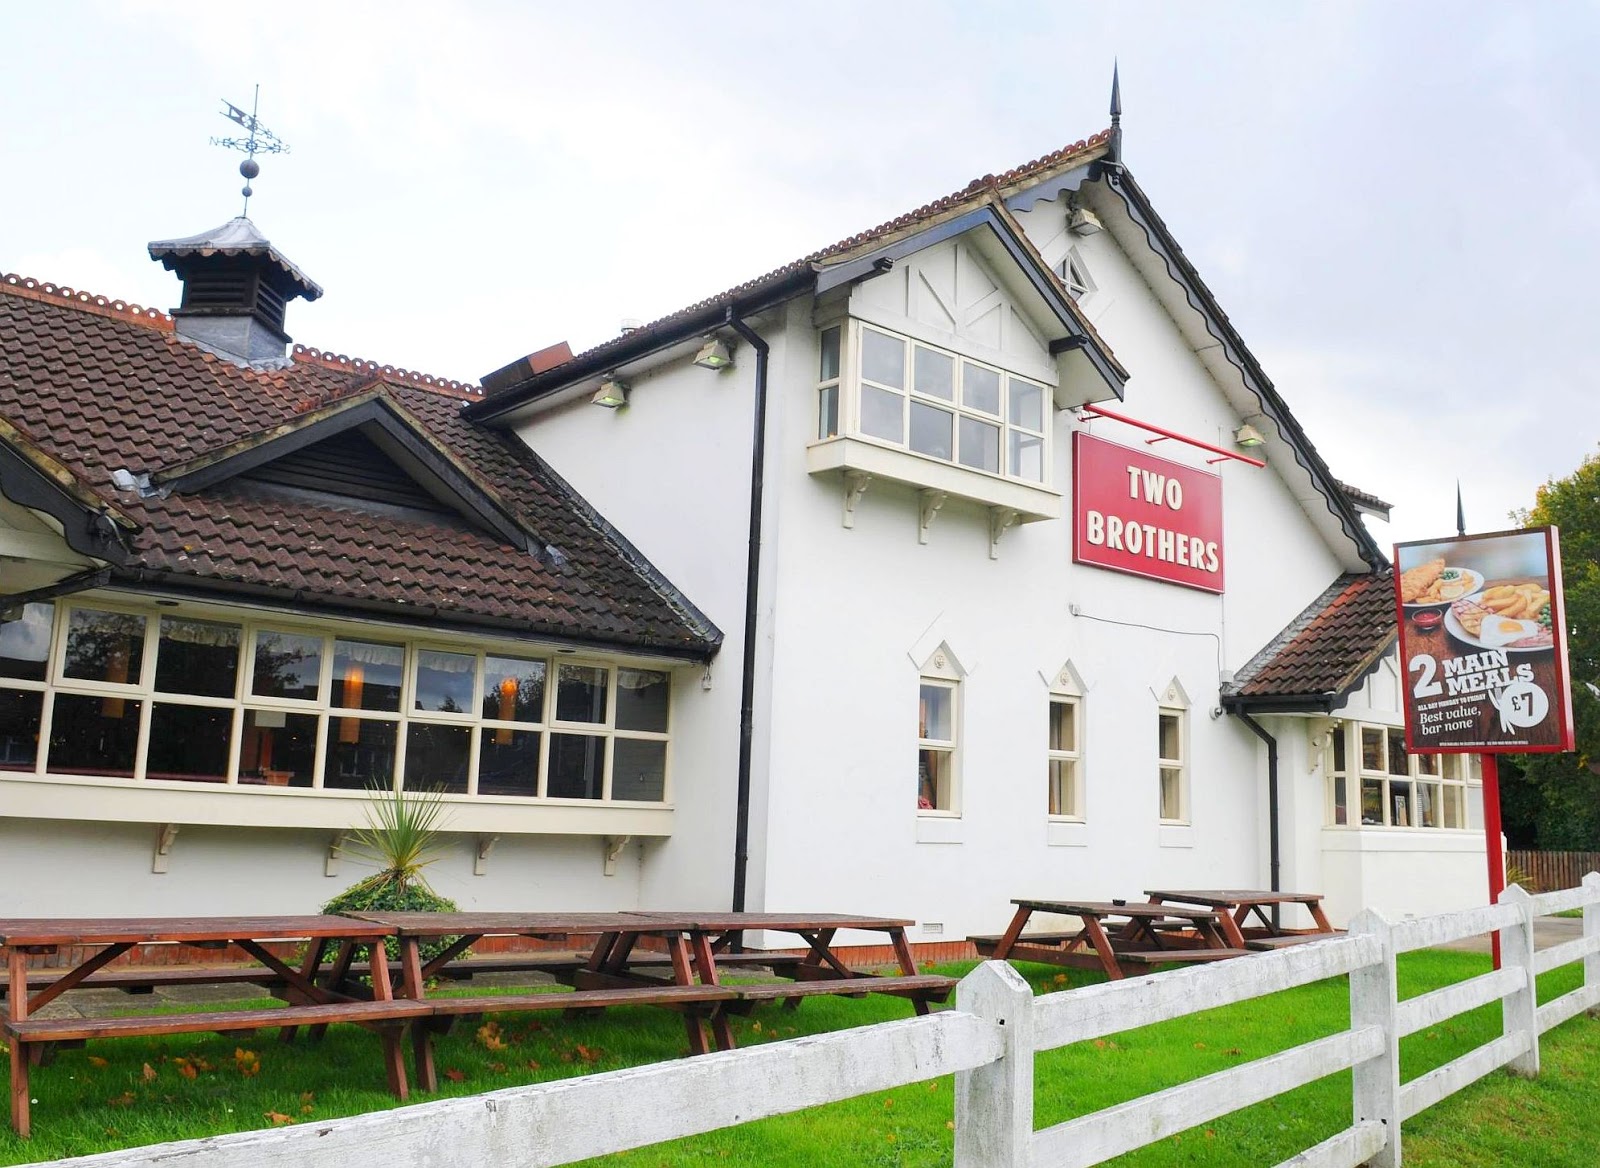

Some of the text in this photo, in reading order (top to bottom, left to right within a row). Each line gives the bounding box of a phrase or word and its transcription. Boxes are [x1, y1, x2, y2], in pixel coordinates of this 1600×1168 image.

[1126, 465, 1183, 511] TWO
[1086, 510, 1219, 573] BROTHERS
[1408, 653, 1444, 698] 2
[1442, 649, 1509, 678] MAIN
[1446, 662, 1535, 696] MEALS
[1420, 705, 1481, 724] Best value,
[1511, 692, 1534, 717] £7
[1422, 719, 1473, 735] bar none
